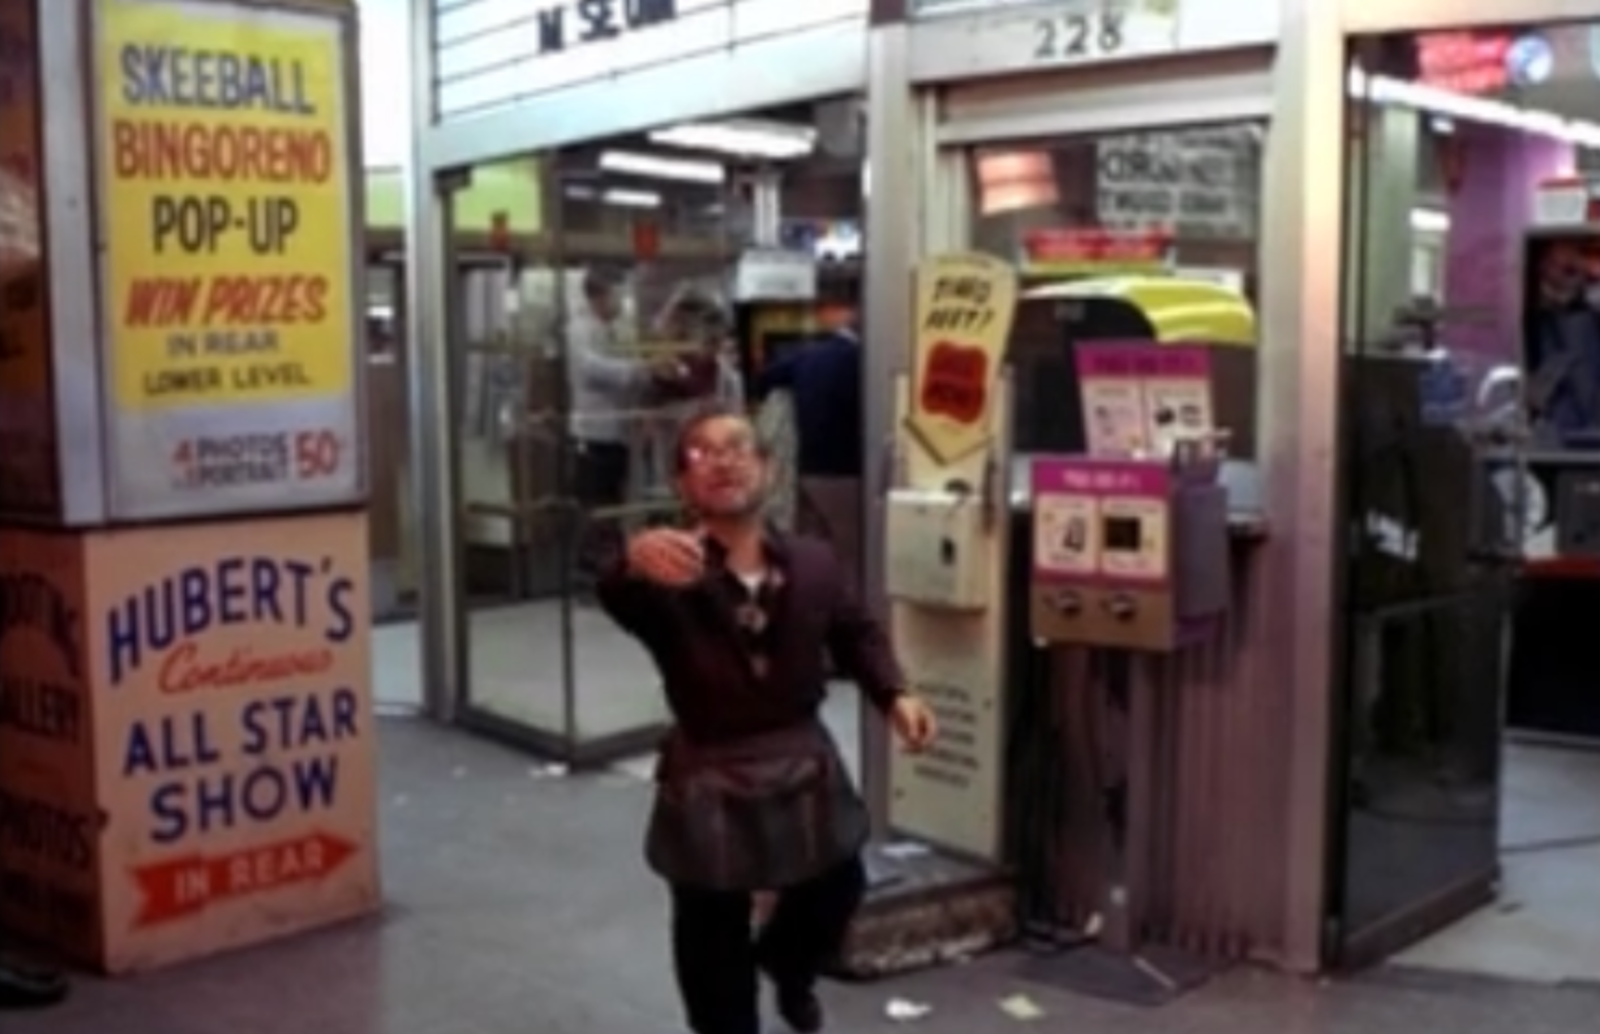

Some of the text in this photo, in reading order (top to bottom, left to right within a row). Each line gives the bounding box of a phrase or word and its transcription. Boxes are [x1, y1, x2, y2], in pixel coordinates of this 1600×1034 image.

[1034, 16, 1123, 58] 228
[120, 43, 315, 115] SKEEBALL
[113, 119, 331, 184] BINGORENO
[152, 194, 299, 256] POP-UP
[124, 276, 328, 329] WIN PRIZES
[167, 330, 279, 358] IN REAR
[144, 362, 311, 395] LOWER LEVEL
[197, 431, 288, 466] PHOTOS
[107, 556, 355, 685] HUBERT'S
[158, 641, 334, 694] Continuous
[124, 688, 358, 777] ALL STAR
[150, 757, 338, 843] SHOW
[174, 841, 324, 905] IN REAR
